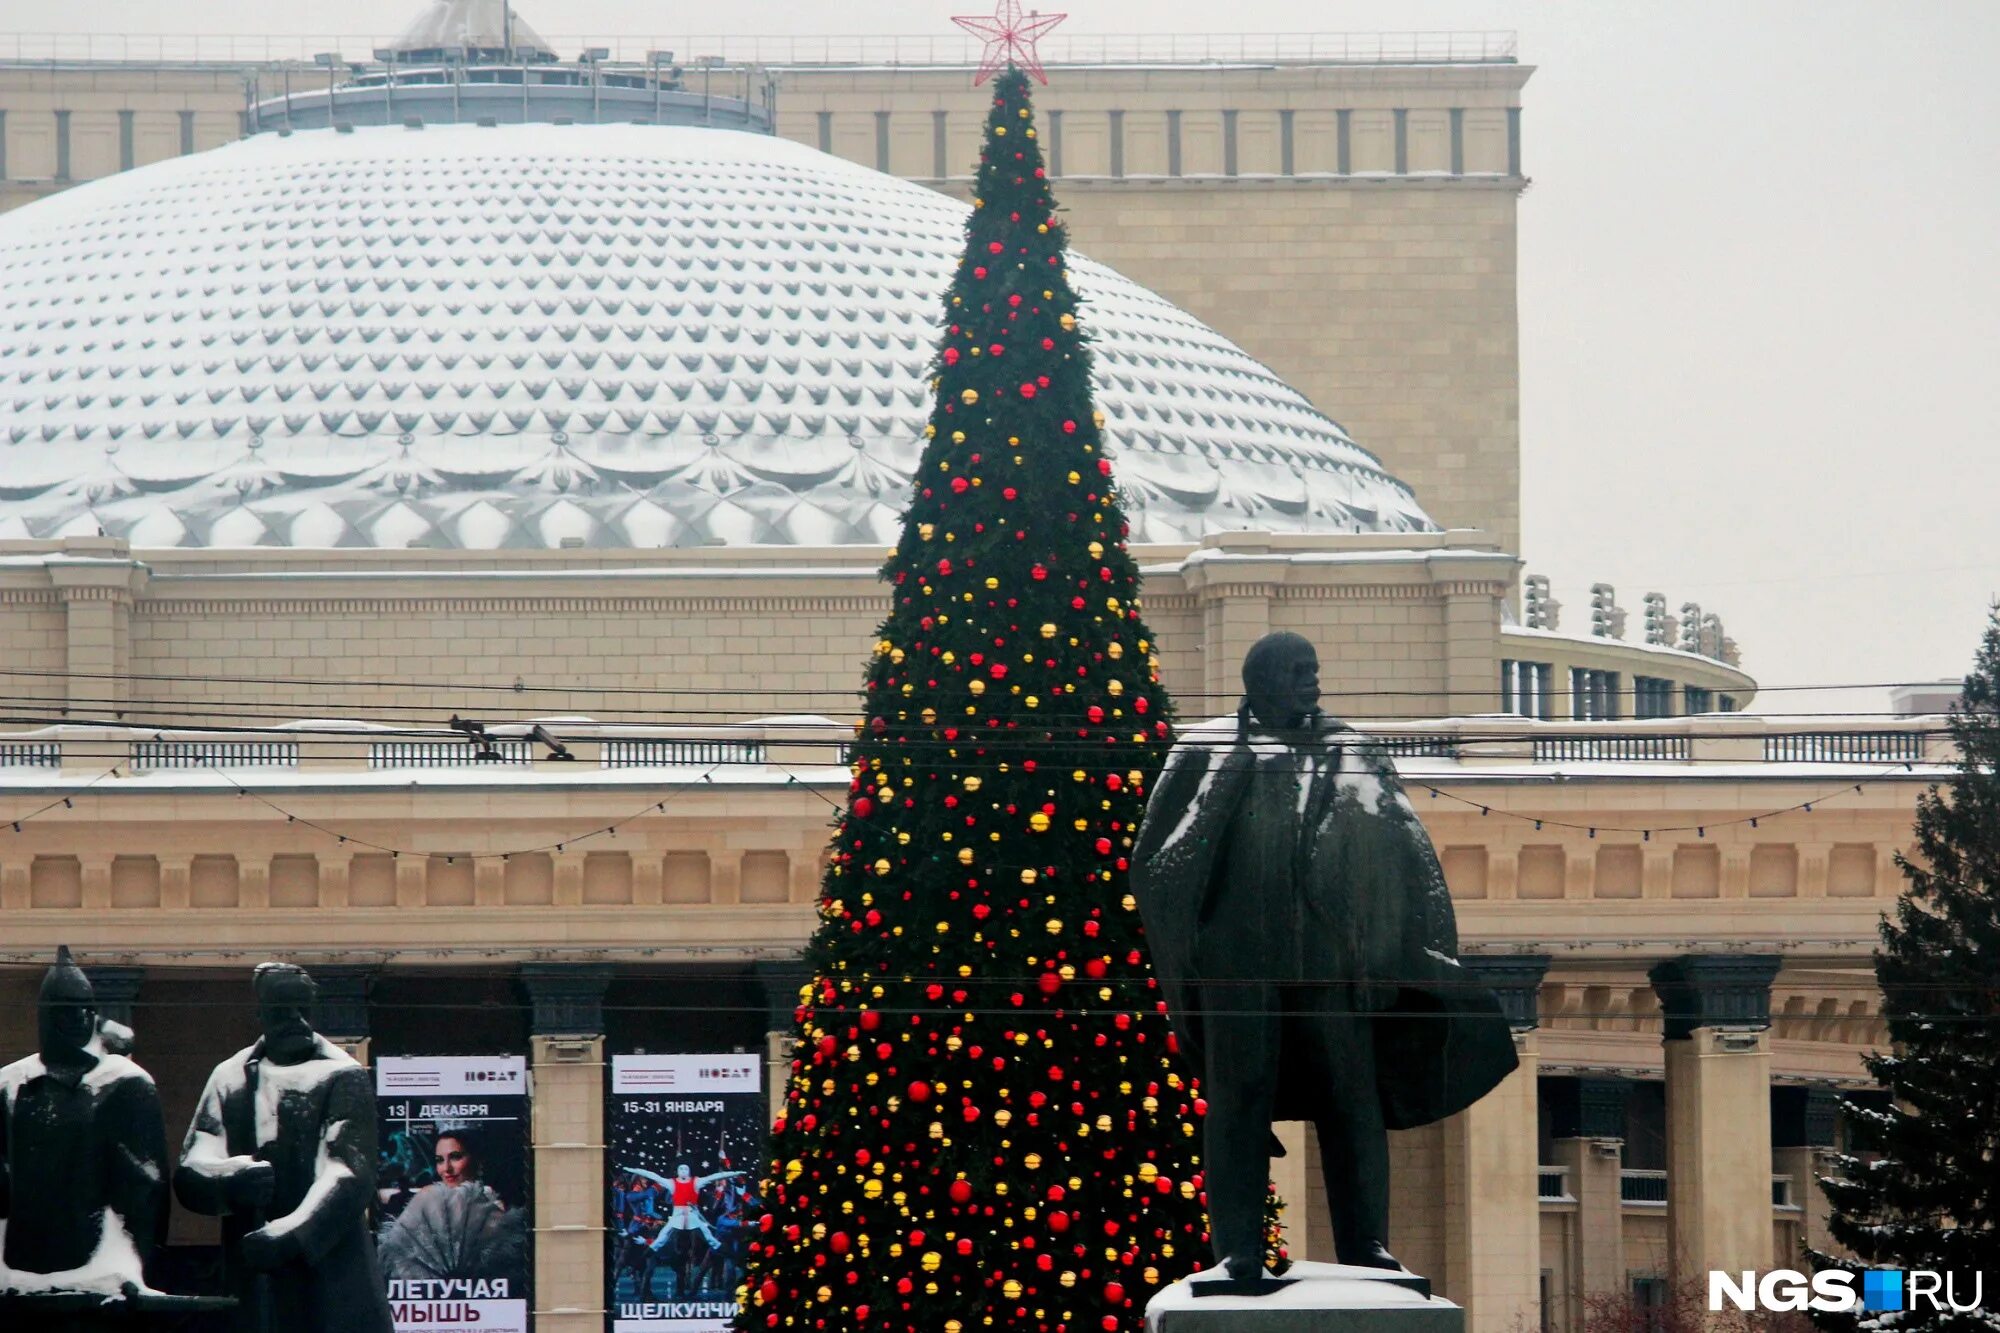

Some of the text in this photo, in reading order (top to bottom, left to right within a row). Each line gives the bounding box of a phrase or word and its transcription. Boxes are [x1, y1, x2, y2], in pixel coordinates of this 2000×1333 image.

[388, 1104, 489, 1117] 13 ДЕКАБРЯ
[623, 1100, 725, 1113] 15-31 ЯНВАРЯ
[386, 1278, 509, 1299] ЛЕТУЧАЯ
[389, 1303, 480, 1323] МЫШЬ
[621, 1302, 738, 1321] ЩЕЛКУНЧИ
